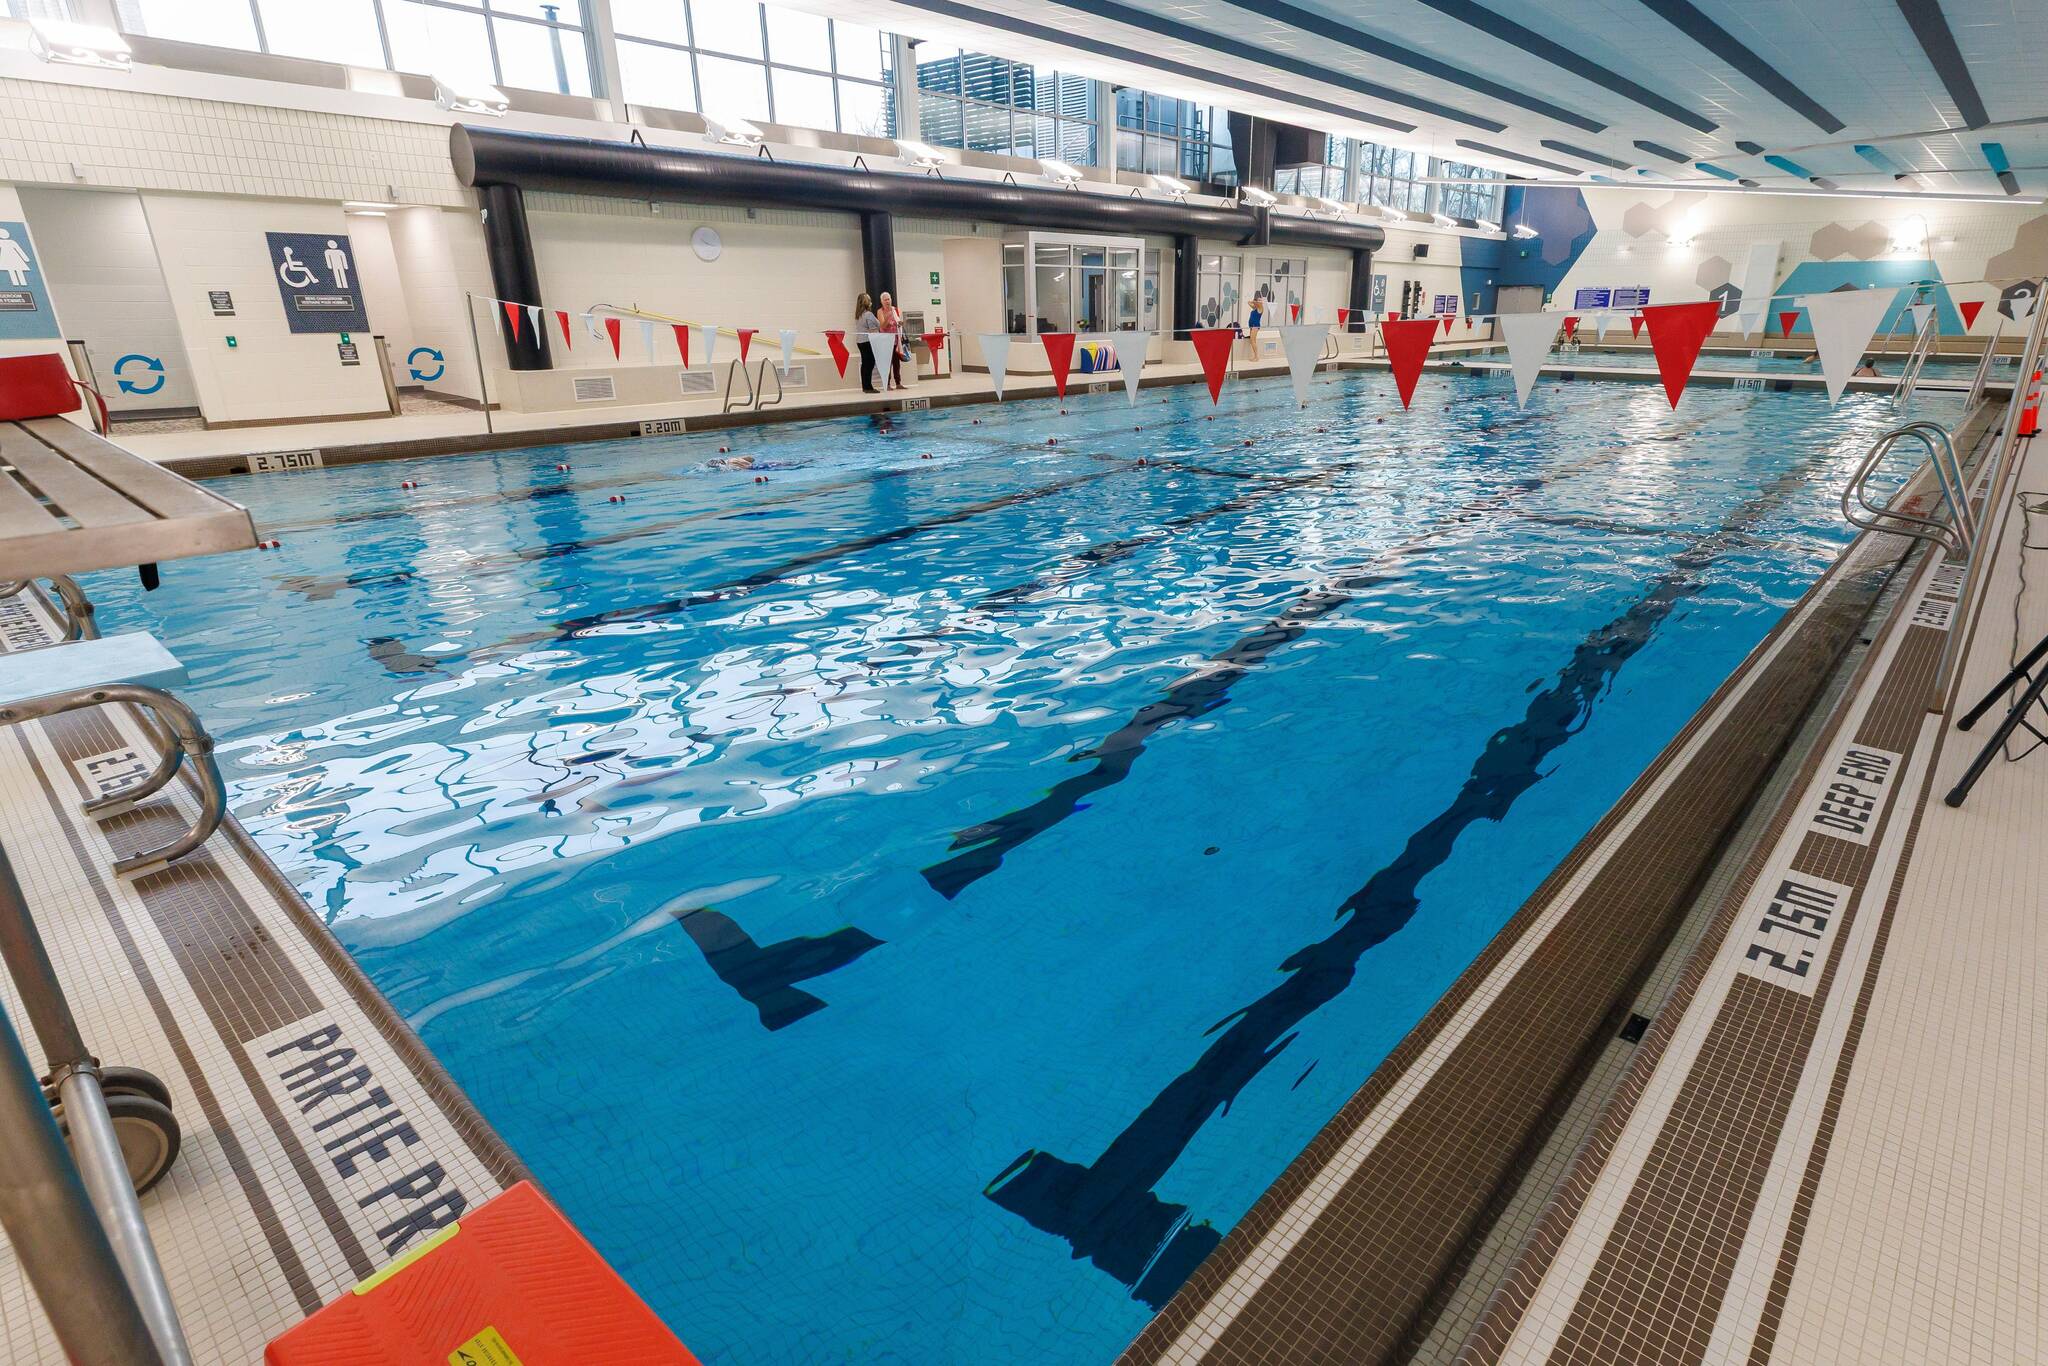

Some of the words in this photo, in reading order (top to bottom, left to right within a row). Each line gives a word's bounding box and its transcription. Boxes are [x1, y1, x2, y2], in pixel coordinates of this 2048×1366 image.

[1718, 290, 1729, 312] 1
[1836, 750, 1892, 785] END
[1812, 782, 1877, 835] DEEP
[266, 1023, 421, 1180] PARTIE
